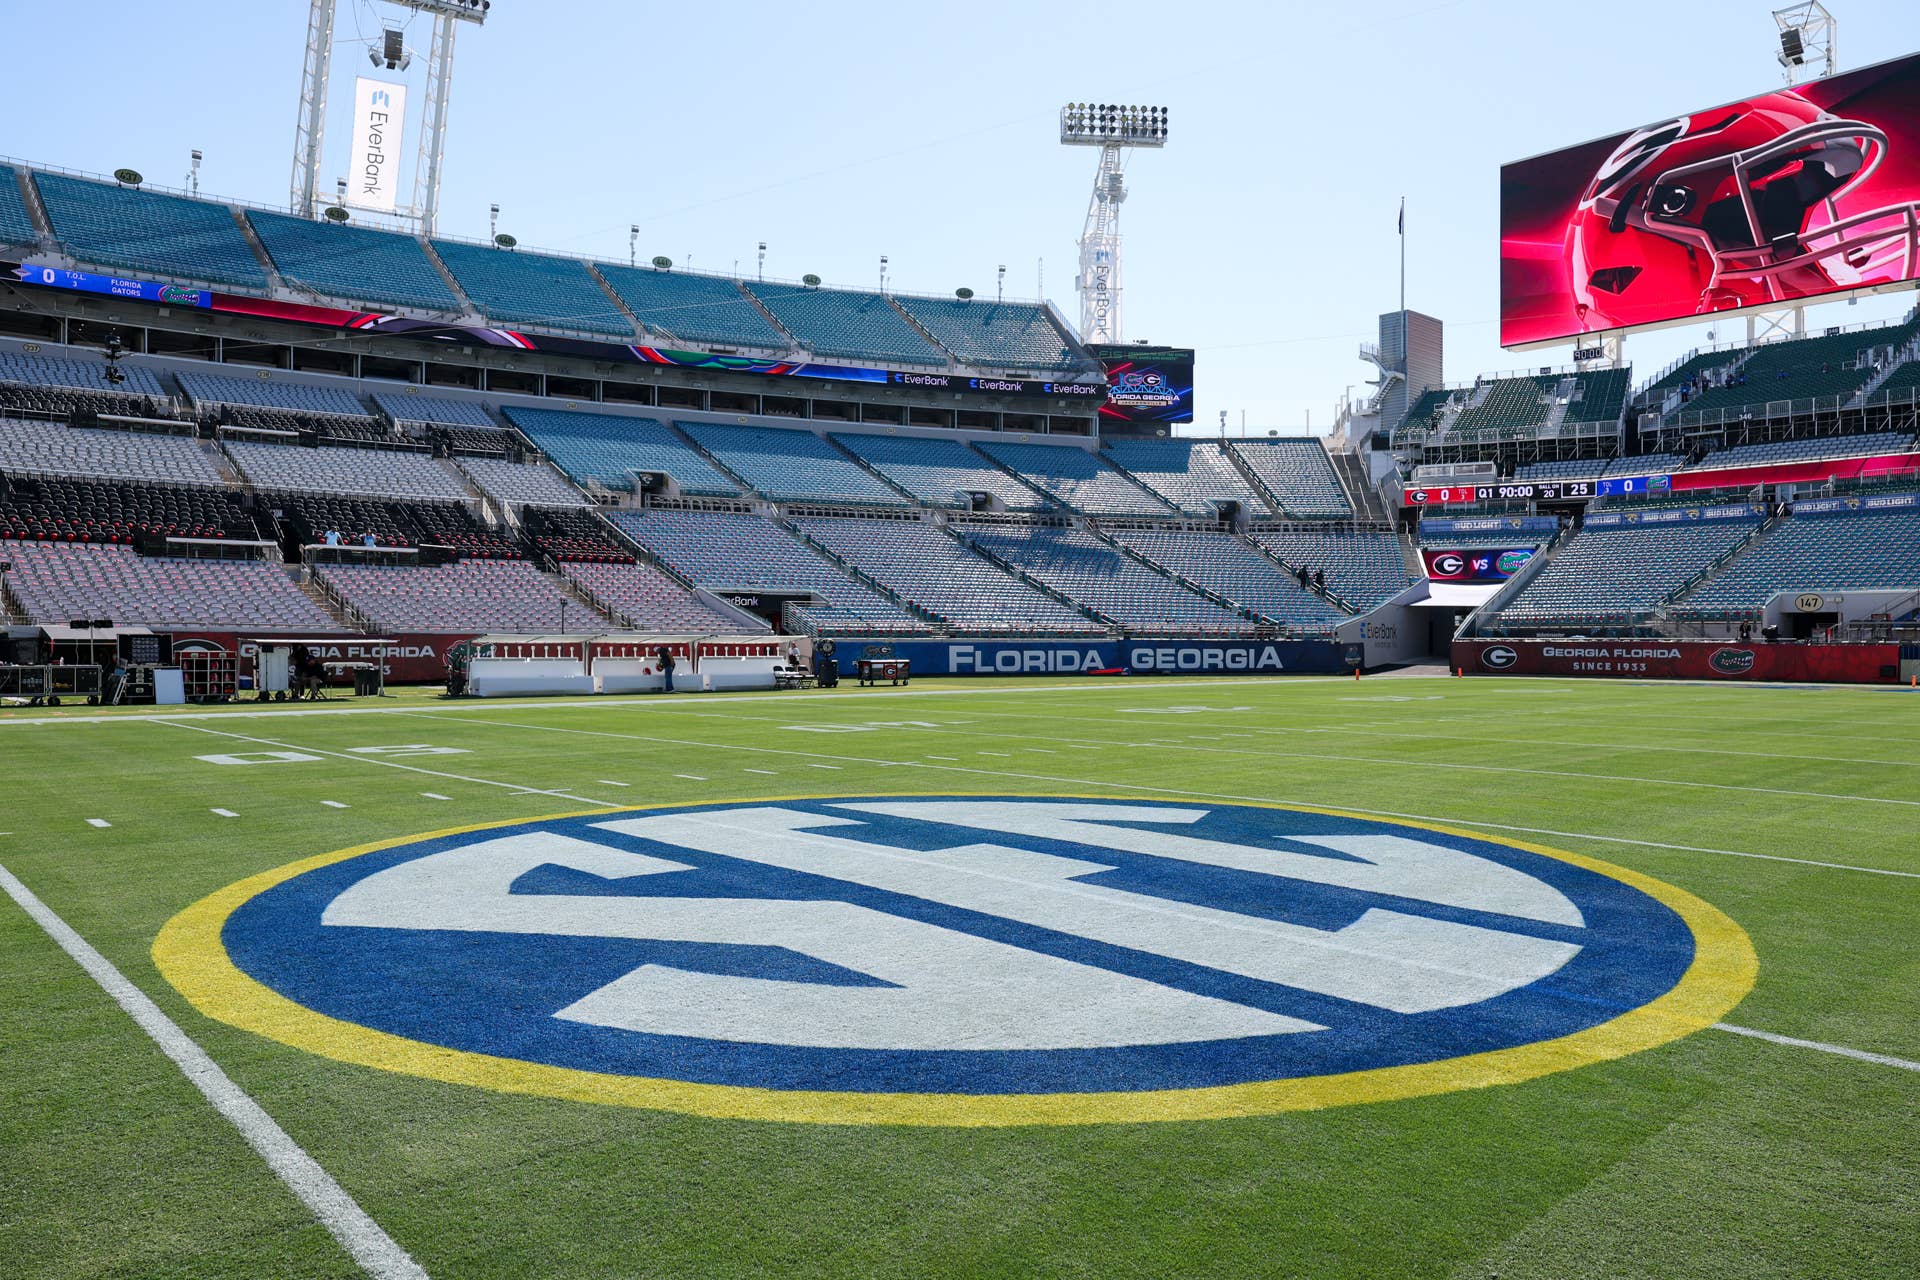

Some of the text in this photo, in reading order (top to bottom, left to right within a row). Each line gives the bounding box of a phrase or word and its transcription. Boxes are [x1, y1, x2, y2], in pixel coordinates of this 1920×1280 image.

[363, 111, 389, 195] EverBank
[42, 268, 55, 283] 0
[111, 278, 142, 289] FLORIDA
[111, 287, 141, 297] GATORS
[1096, 266, 1111, 336] EverBank
[1574, 349, 1602, 360] 90:00
[904, 373, 948, 386] EverBank
[979, 379, 1023, 391] EverBank
[1053, 383, 1096, 394] EverBank
[1570, 483, 1588, 495] 25
[1624, 480, 1633, 491] 0
[1440, 489, 1449, 501] 0
[1479, 486, 1533, 498] Q1 90:00
[1543, 489, 1555, 498] 20
[1886, 498, 1913, 506] LIGHT
[1659, 512, 1681, 520] LIGHT
[1722, 508, 1745, 516] LIGHT
[1432, 554, 1464, 576] G
[1472, 559, 1489, 570] VS
[725, 596, 759, 606] erBank
[1800, 598, 1819, 608] 147
[1367, 622, 1397, 639] EverBank
[240, 643, 436, 658] GGIA FLORIDA
[1543, 646, 1682, 659] GEORGIA FLORIDA
[948, 645, 1284, 673] FLORIDA GEORGIA
[1481, 645, 1518, 669] G
[1573, 661, 1647, 672] SINCE 1933
[321, 800, 1585, 1051] SEC
